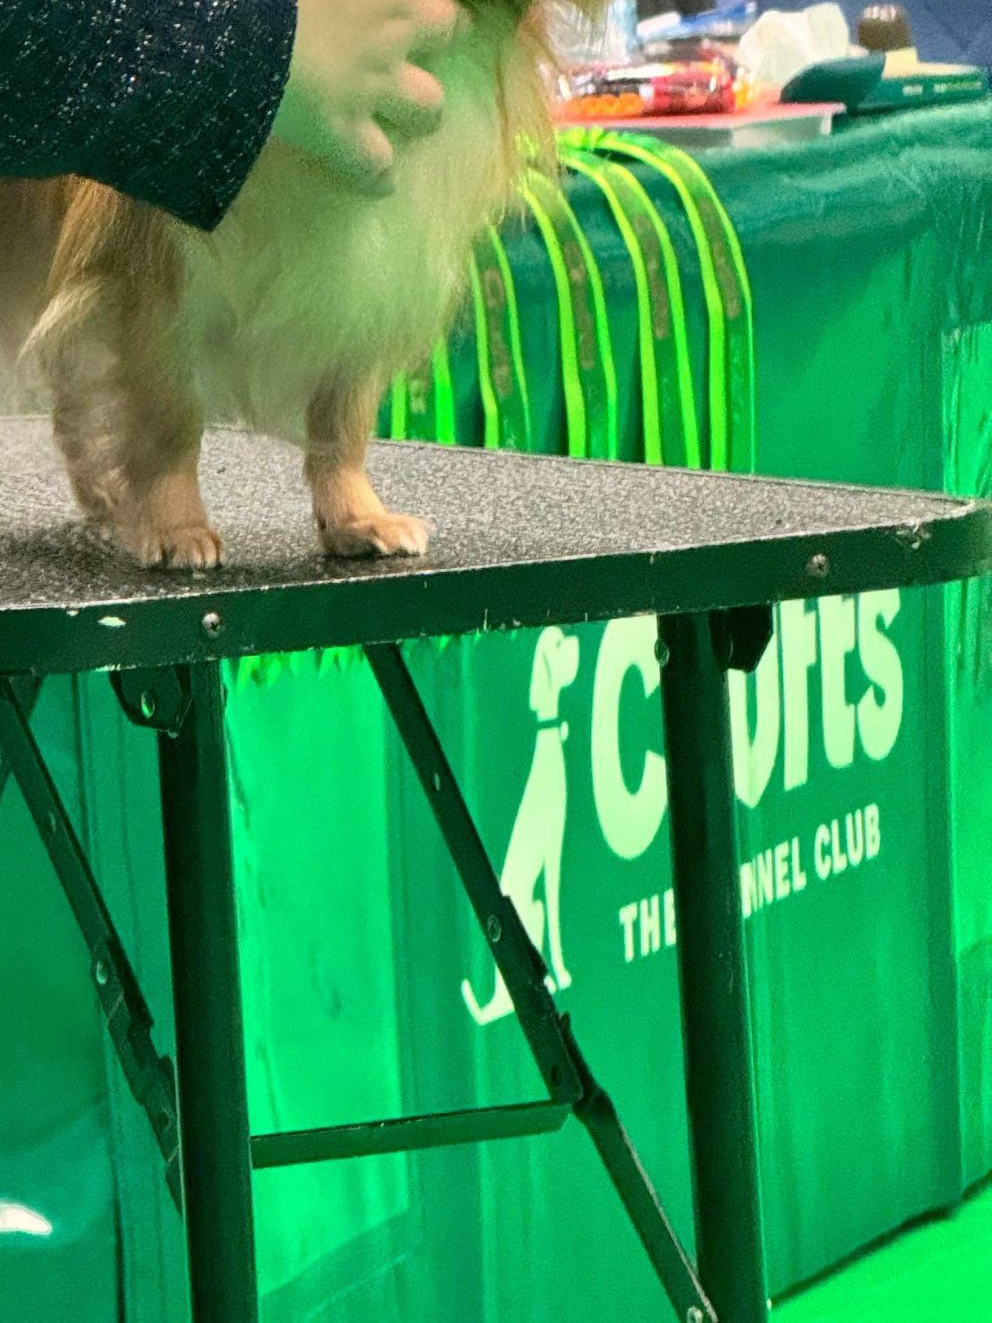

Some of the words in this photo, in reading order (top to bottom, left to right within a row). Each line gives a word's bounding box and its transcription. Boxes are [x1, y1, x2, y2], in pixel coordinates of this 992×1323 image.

[591, 587, 904, 861] Cufts
[739, 836, 807, 919] NNEL
[814, 802, 881, 880] CLUB
